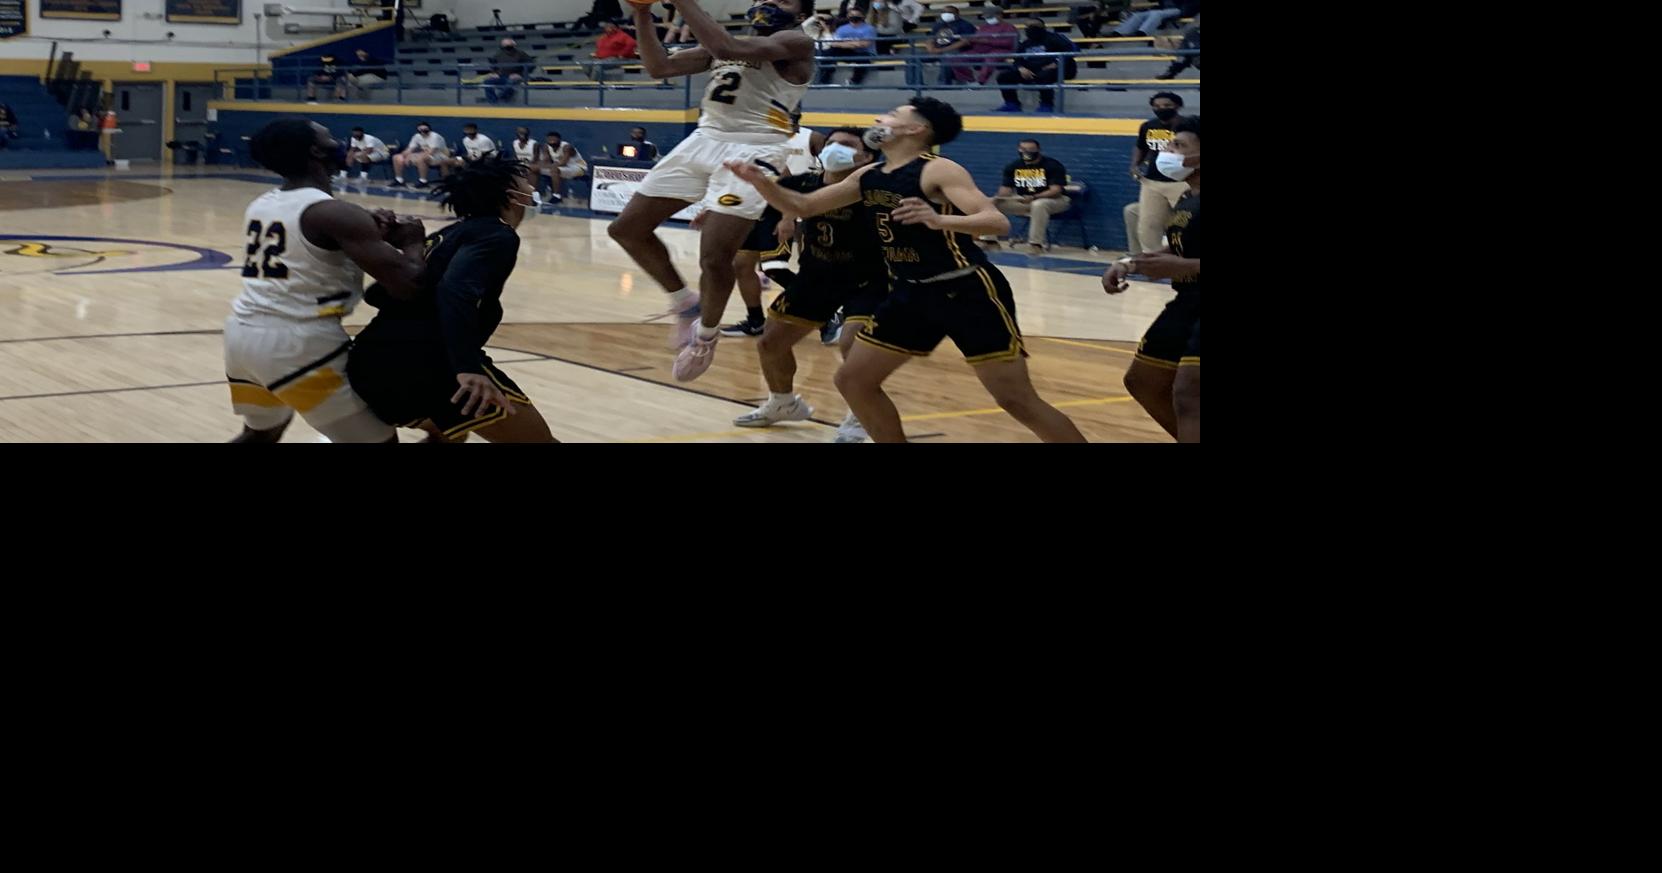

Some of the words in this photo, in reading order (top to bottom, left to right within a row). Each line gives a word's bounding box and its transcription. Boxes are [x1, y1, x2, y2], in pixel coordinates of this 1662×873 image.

[816, 221, 834, 248] 3
[875, 212, 895, 243] 5
[241, 218, 289, 279] 22
